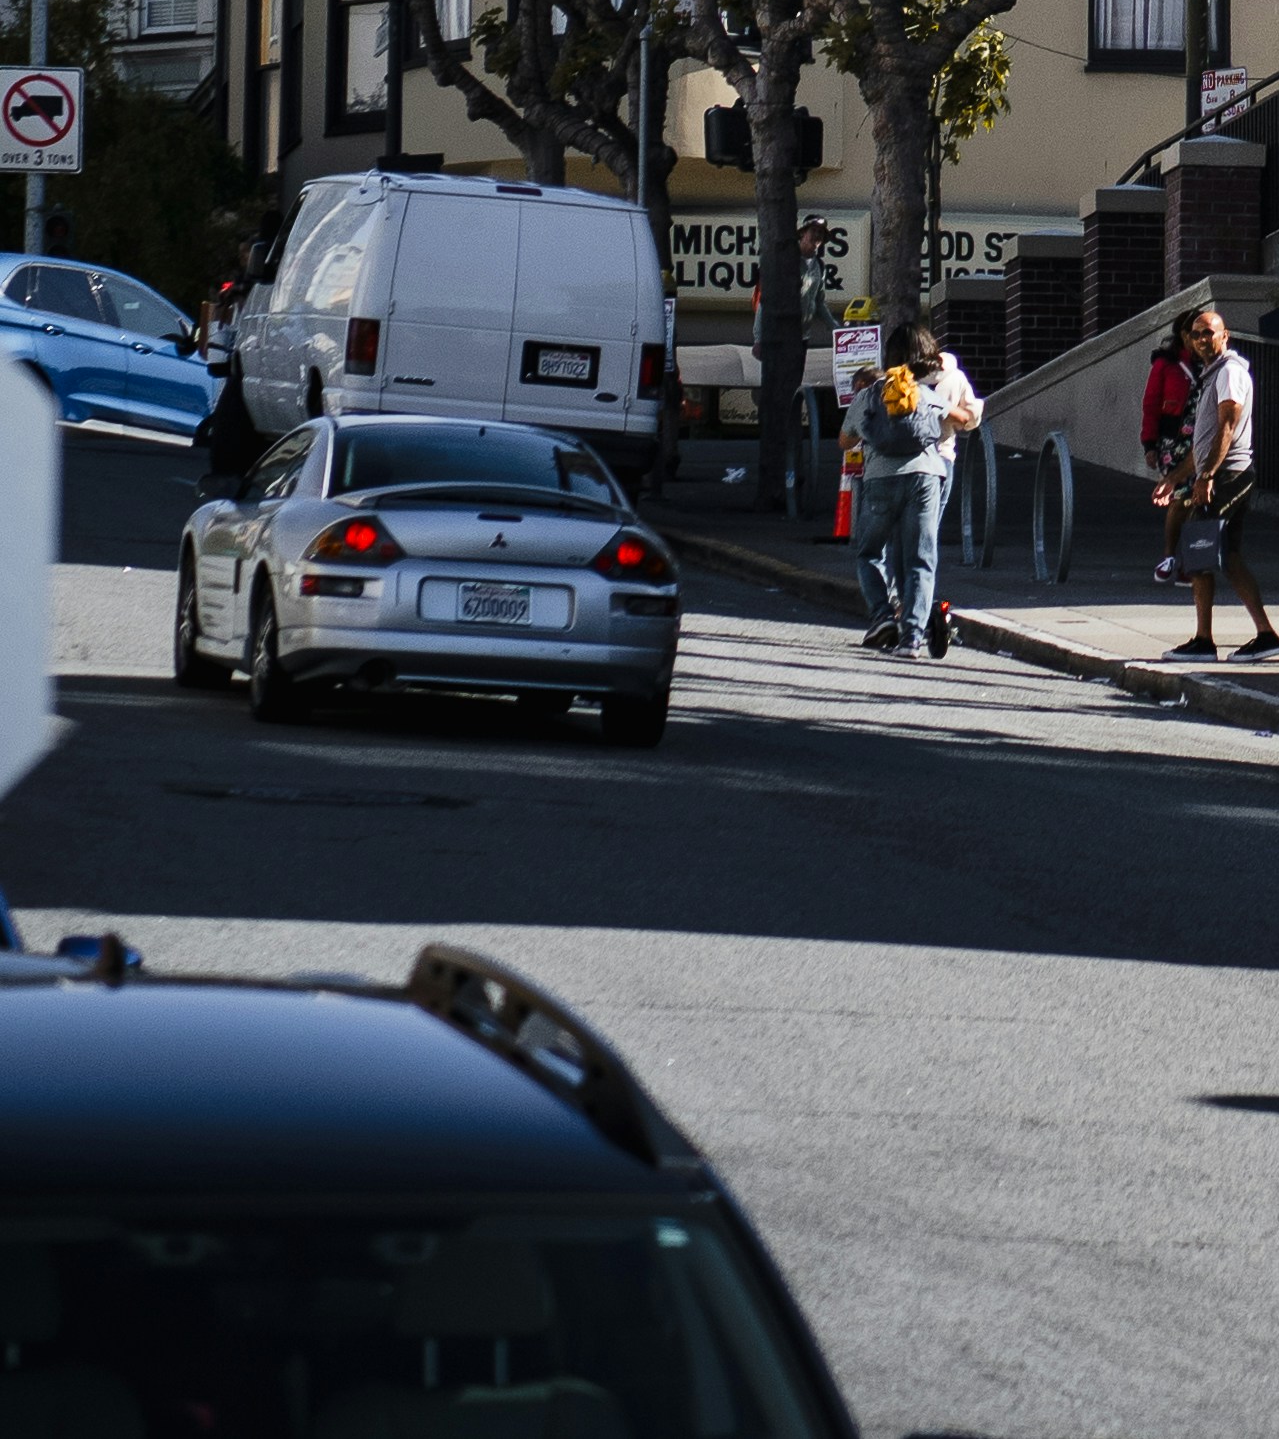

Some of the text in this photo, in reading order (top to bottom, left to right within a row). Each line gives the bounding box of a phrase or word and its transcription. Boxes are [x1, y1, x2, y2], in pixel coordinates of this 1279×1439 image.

[1202, 73, 1214, 90] NO
[2, 149, 74, 166] OVER 3 TONS
[920, 231, 975, 261] OOD
